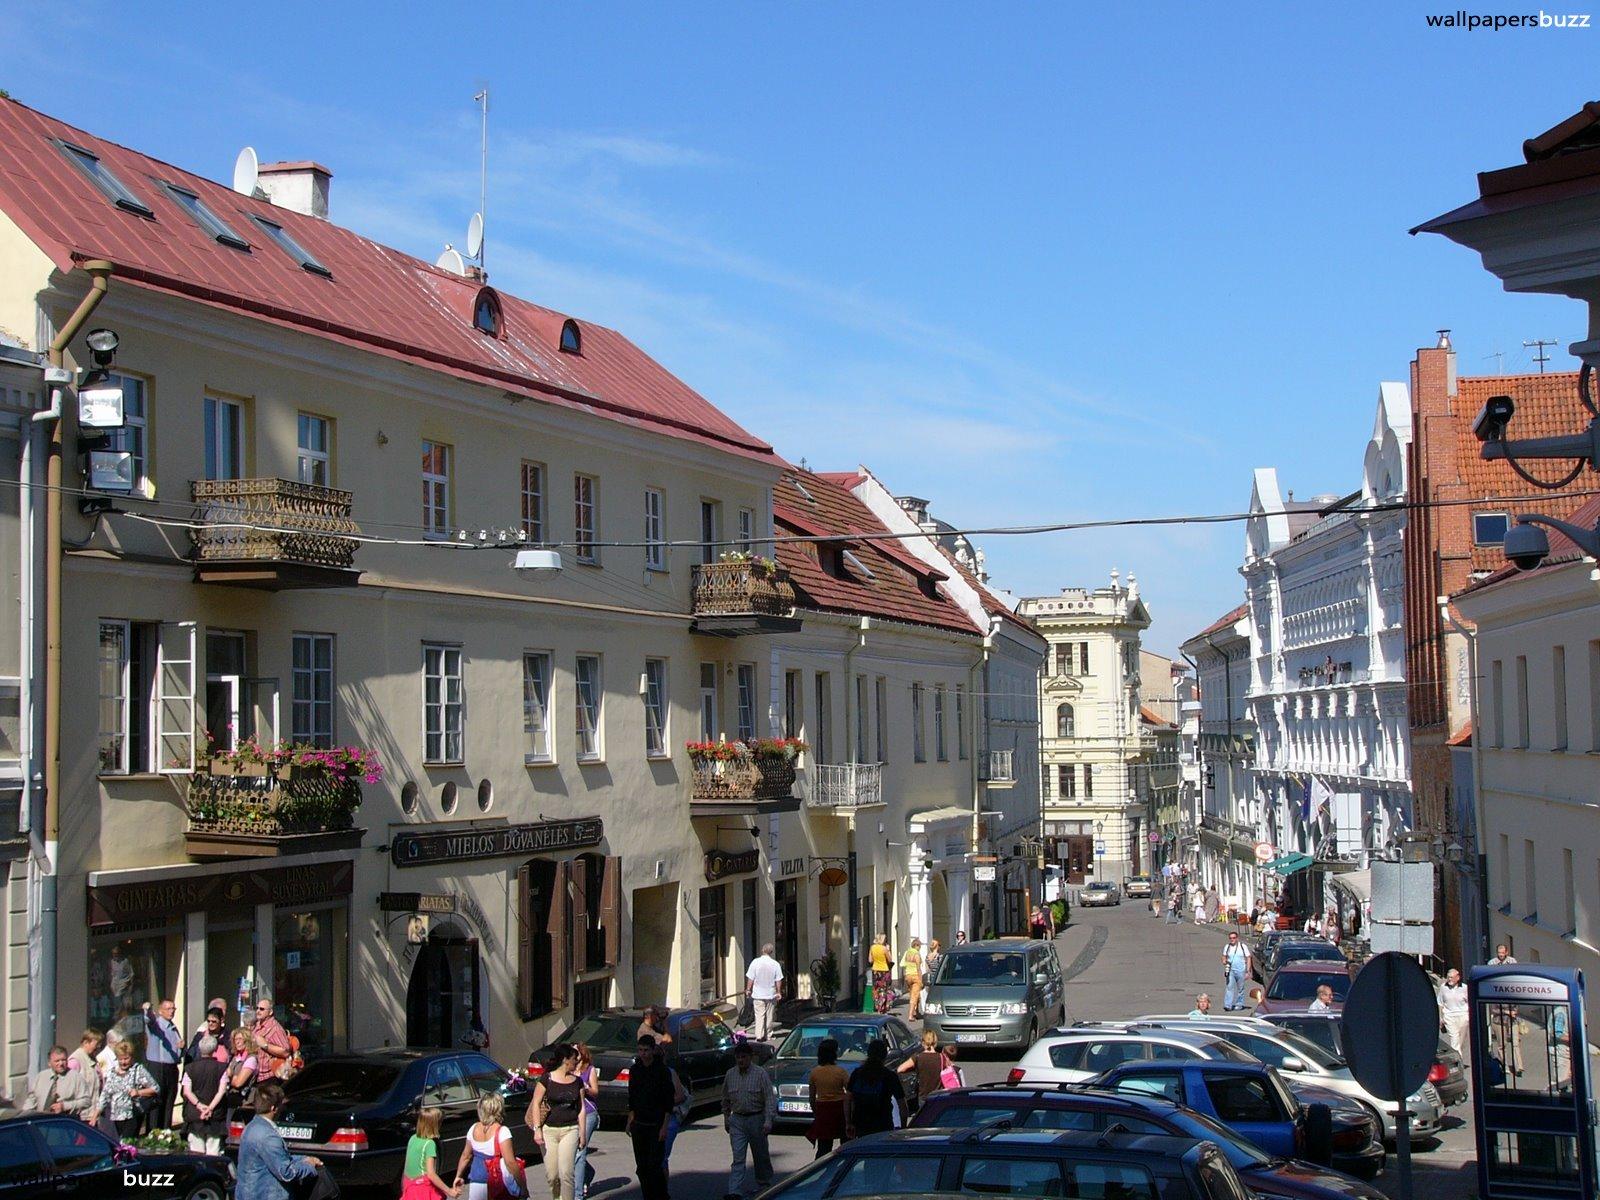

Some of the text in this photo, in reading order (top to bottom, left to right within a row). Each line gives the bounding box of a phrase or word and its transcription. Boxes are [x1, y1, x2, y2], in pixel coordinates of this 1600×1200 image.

[445, 834, 494, 858] MIELOS
[781, 858, 804, 876] VELITA
[116, 884, 201, 913] GINTARAS
[1493, 985, 1552, 994] TAKSOFONAS
